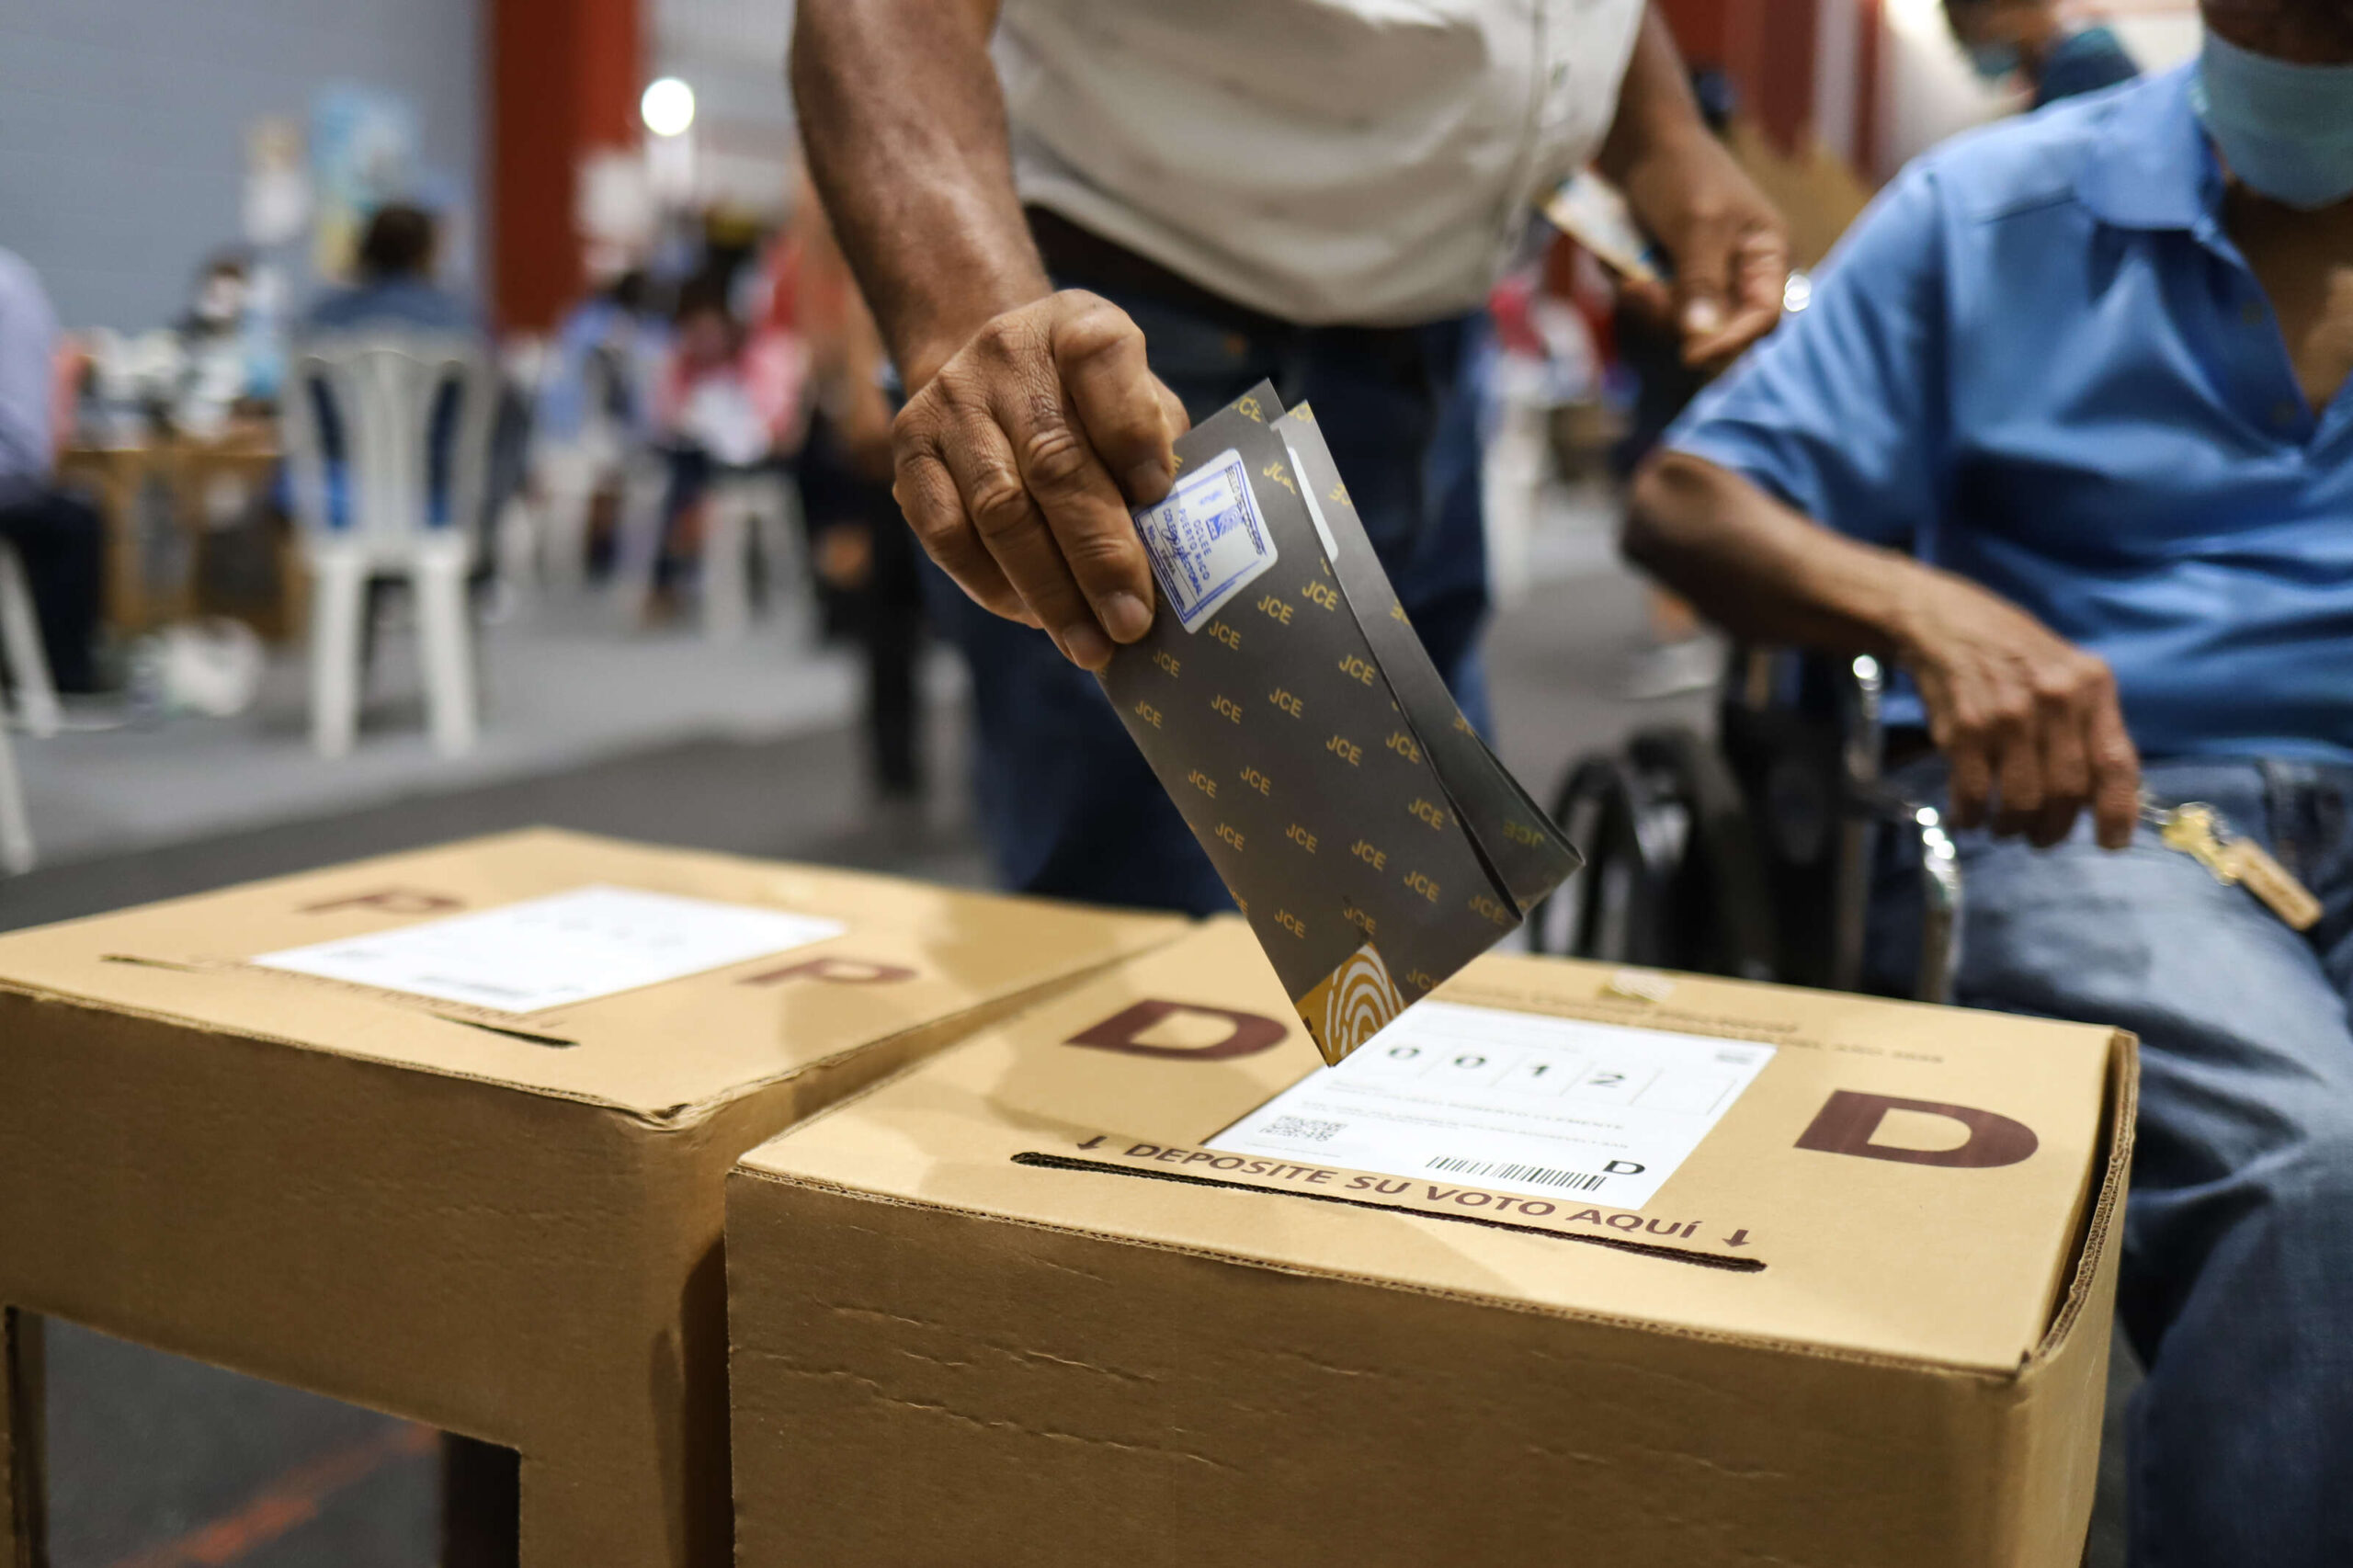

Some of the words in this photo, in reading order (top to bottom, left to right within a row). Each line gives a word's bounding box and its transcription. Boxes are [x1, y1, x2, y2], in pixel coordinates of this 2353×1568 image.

[1178, 507, 1198, 551] PUERTO
[1195, 552, 1211, 581] RICO
[1193, 518, 1212, 557] OCLEE
[1257, 595, 1294, 625] JCE
[1302, 580, 1339, 611] JCE
[1209, 620, 1242, 651] JCE
[1153, 648, 1181, 678] JCE
[1339, 654, 1375, 687] JCE
[1134, 700, 1163, 729] JCE
[1211, 694, 1243, 724] JCE
[1269, 687, 1304, 720] JCE
[1326, 735, 1362, 767] JCE
[1386, 732, 1421, 765] JCE
[1188, 768, 1217, 799] JCE
[1241, 766, 1271, 796] JCE
[1408, 798, 1446, 831] JCE
[1215, 823, 1245, 852] JCE
[1287, 824, 1318, 854] JCE
[1351, 839, 1387, 871] JCE
[1404, 871, 1441, 903] JCE
[1274, 908, 1305, 938] JCE
[1343, 907, 1376, 936] JCE
[1061, 998, 1290, 1062] D
[1793, 1088, 2040, 1168] D
[1123, 1143, 1338, 1186] DEPOSITE
[1345, 1176, 1409, 1196] SU
[1426, 1186, 1556, 1217] VOTO
[1602, 1160, 1646, 1176] D
